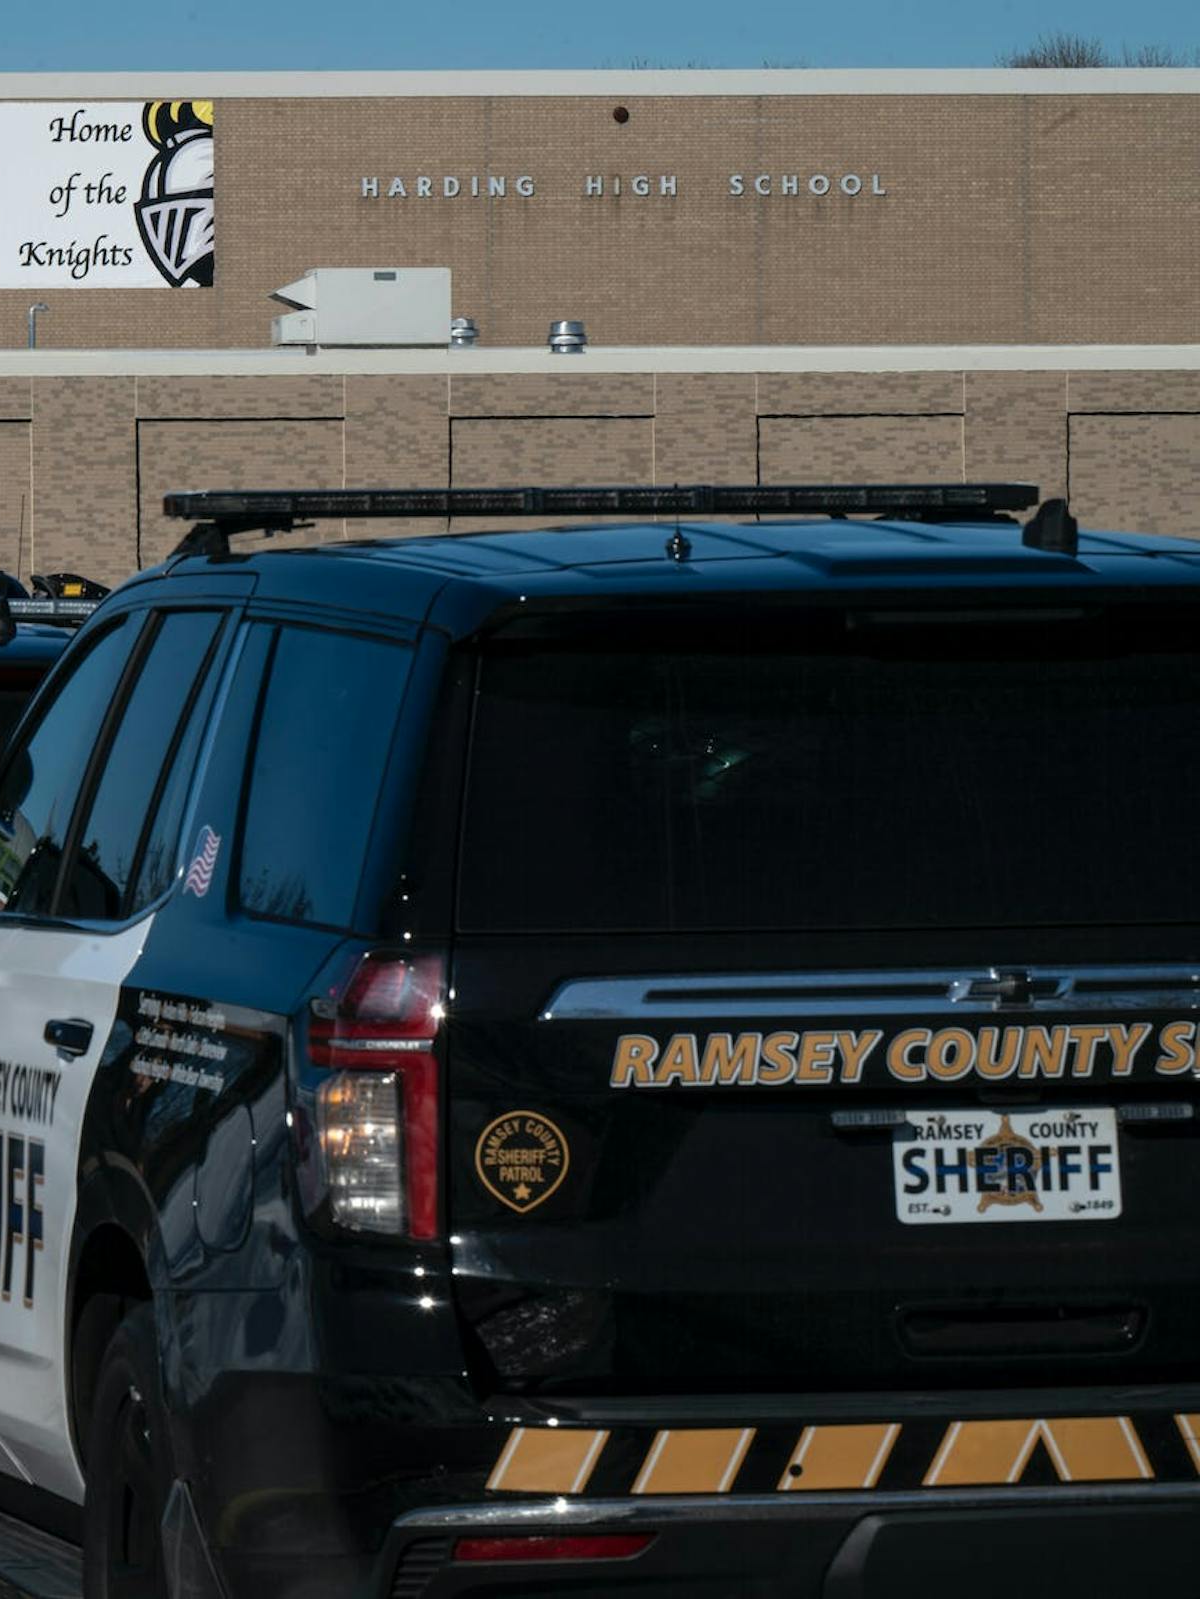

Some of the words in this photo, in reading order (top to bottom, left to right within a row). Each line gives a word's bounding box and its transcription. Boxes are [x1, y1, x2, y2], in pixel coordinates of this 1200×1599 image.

[49, 109, 132, 142] Home
[50, 172, 81, 218] of
[84, 172, 127, 204] the
[361, 176, 536, 198] HARDING
[586, 175, 678, 197] HIGH
[729, 174, 887, 197] SCHOOL
[19, 235, 132, 280] Knights
[610, 1030, 883, 1087] RAMSEY
[887, 1023, 1152, 1082] COUNTY
[1156, 1021, 1200, 1075] S
[11, 1063, 61, 1126] COUNTY
[525, 1120, 561, 1166] COUNTY
[915, 1124, 984, 1140] RAMSEY
[1029, 1122, 1099, 1139] COUNTY
[497, 1149, 546, 1165] SHERIFF
[499, 1166, 544, 1182] PATROL
[902, 1145, 1114, 1194] SHERIFF
